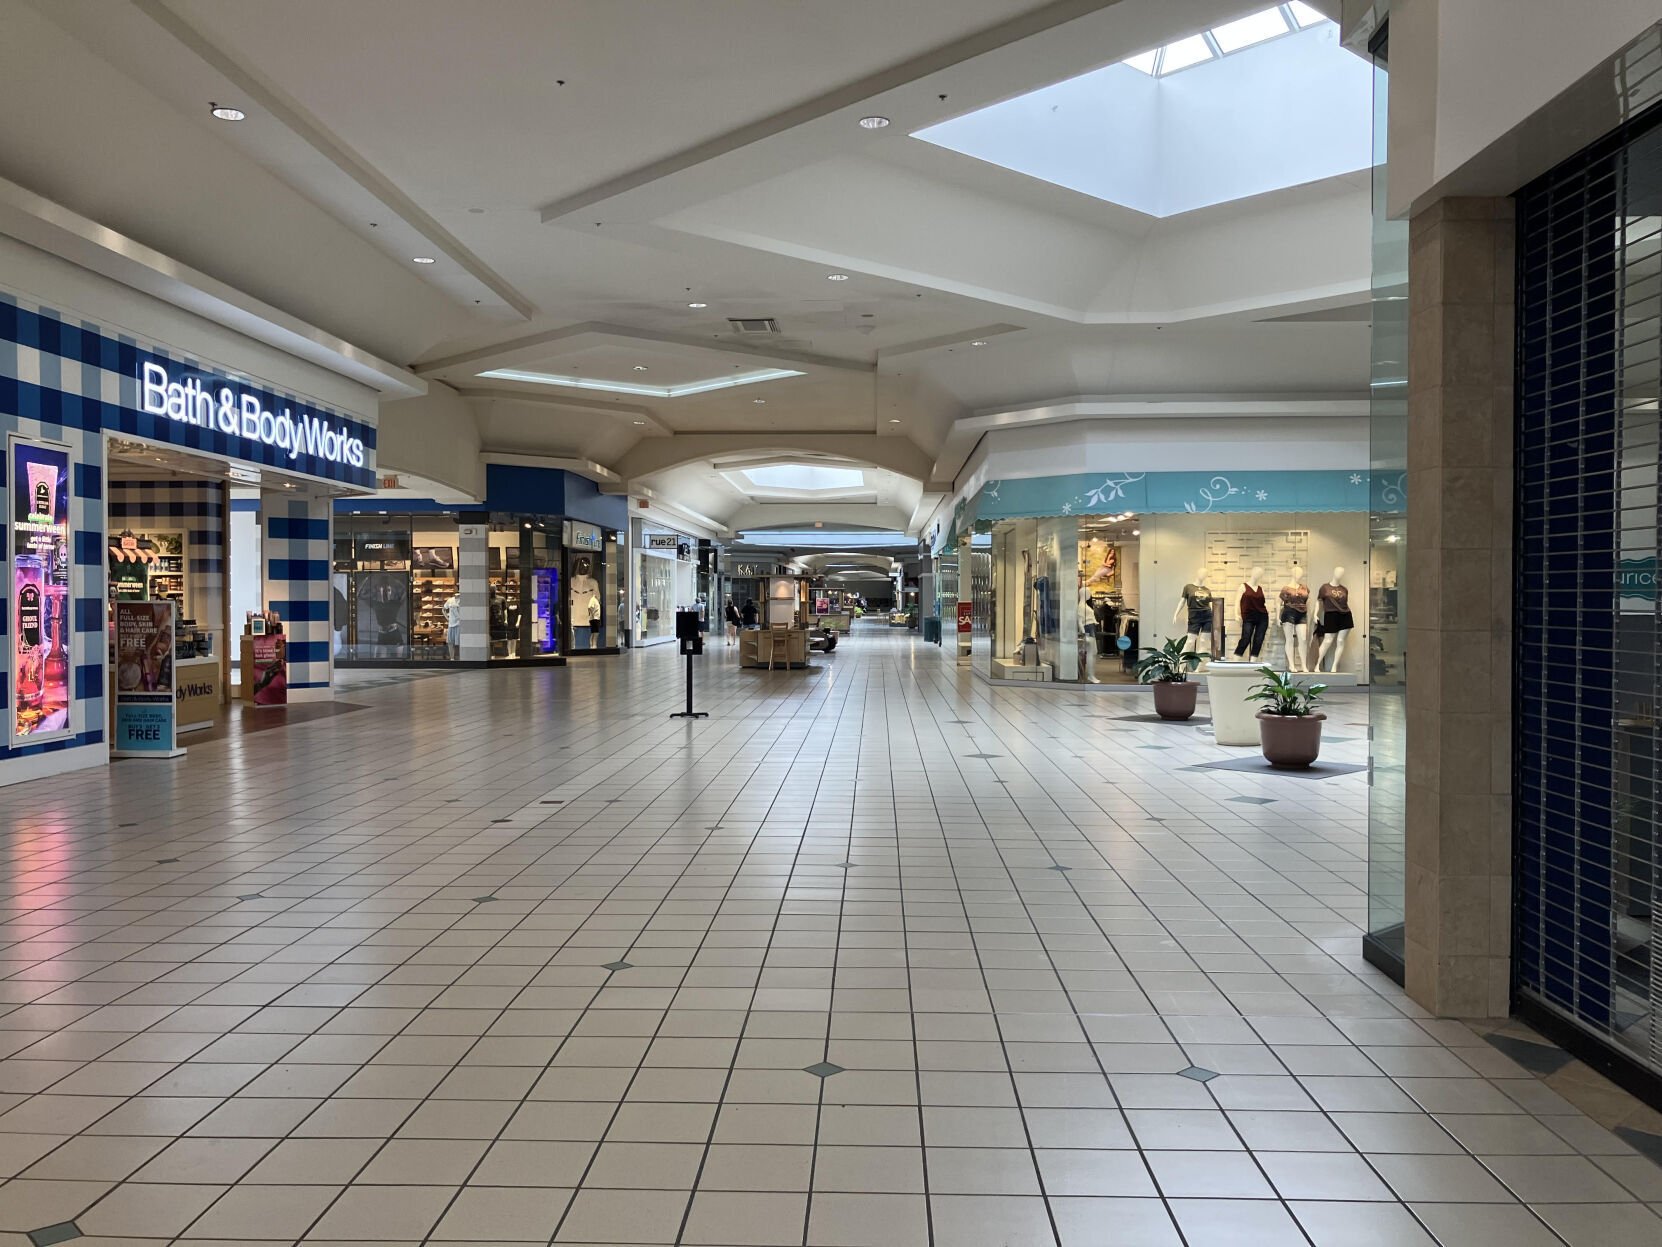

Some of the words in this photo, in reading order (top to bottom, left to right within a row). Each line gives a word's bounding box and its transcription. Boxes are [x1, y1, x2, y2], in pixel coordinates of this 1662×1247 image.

[143, 361, 214, 430] Bath
[217, 387, 239, 436] &
[241, 393, 303, 460] Body
[303, 414, 364, 467] Works
[15, 521, 65, 534] summerween
[651, 538, 676, 546] rue21
[120, 639, 147, 647] FREE
[187, 683, 213, 697] Works
[128, 729, 160, 740] FREE
